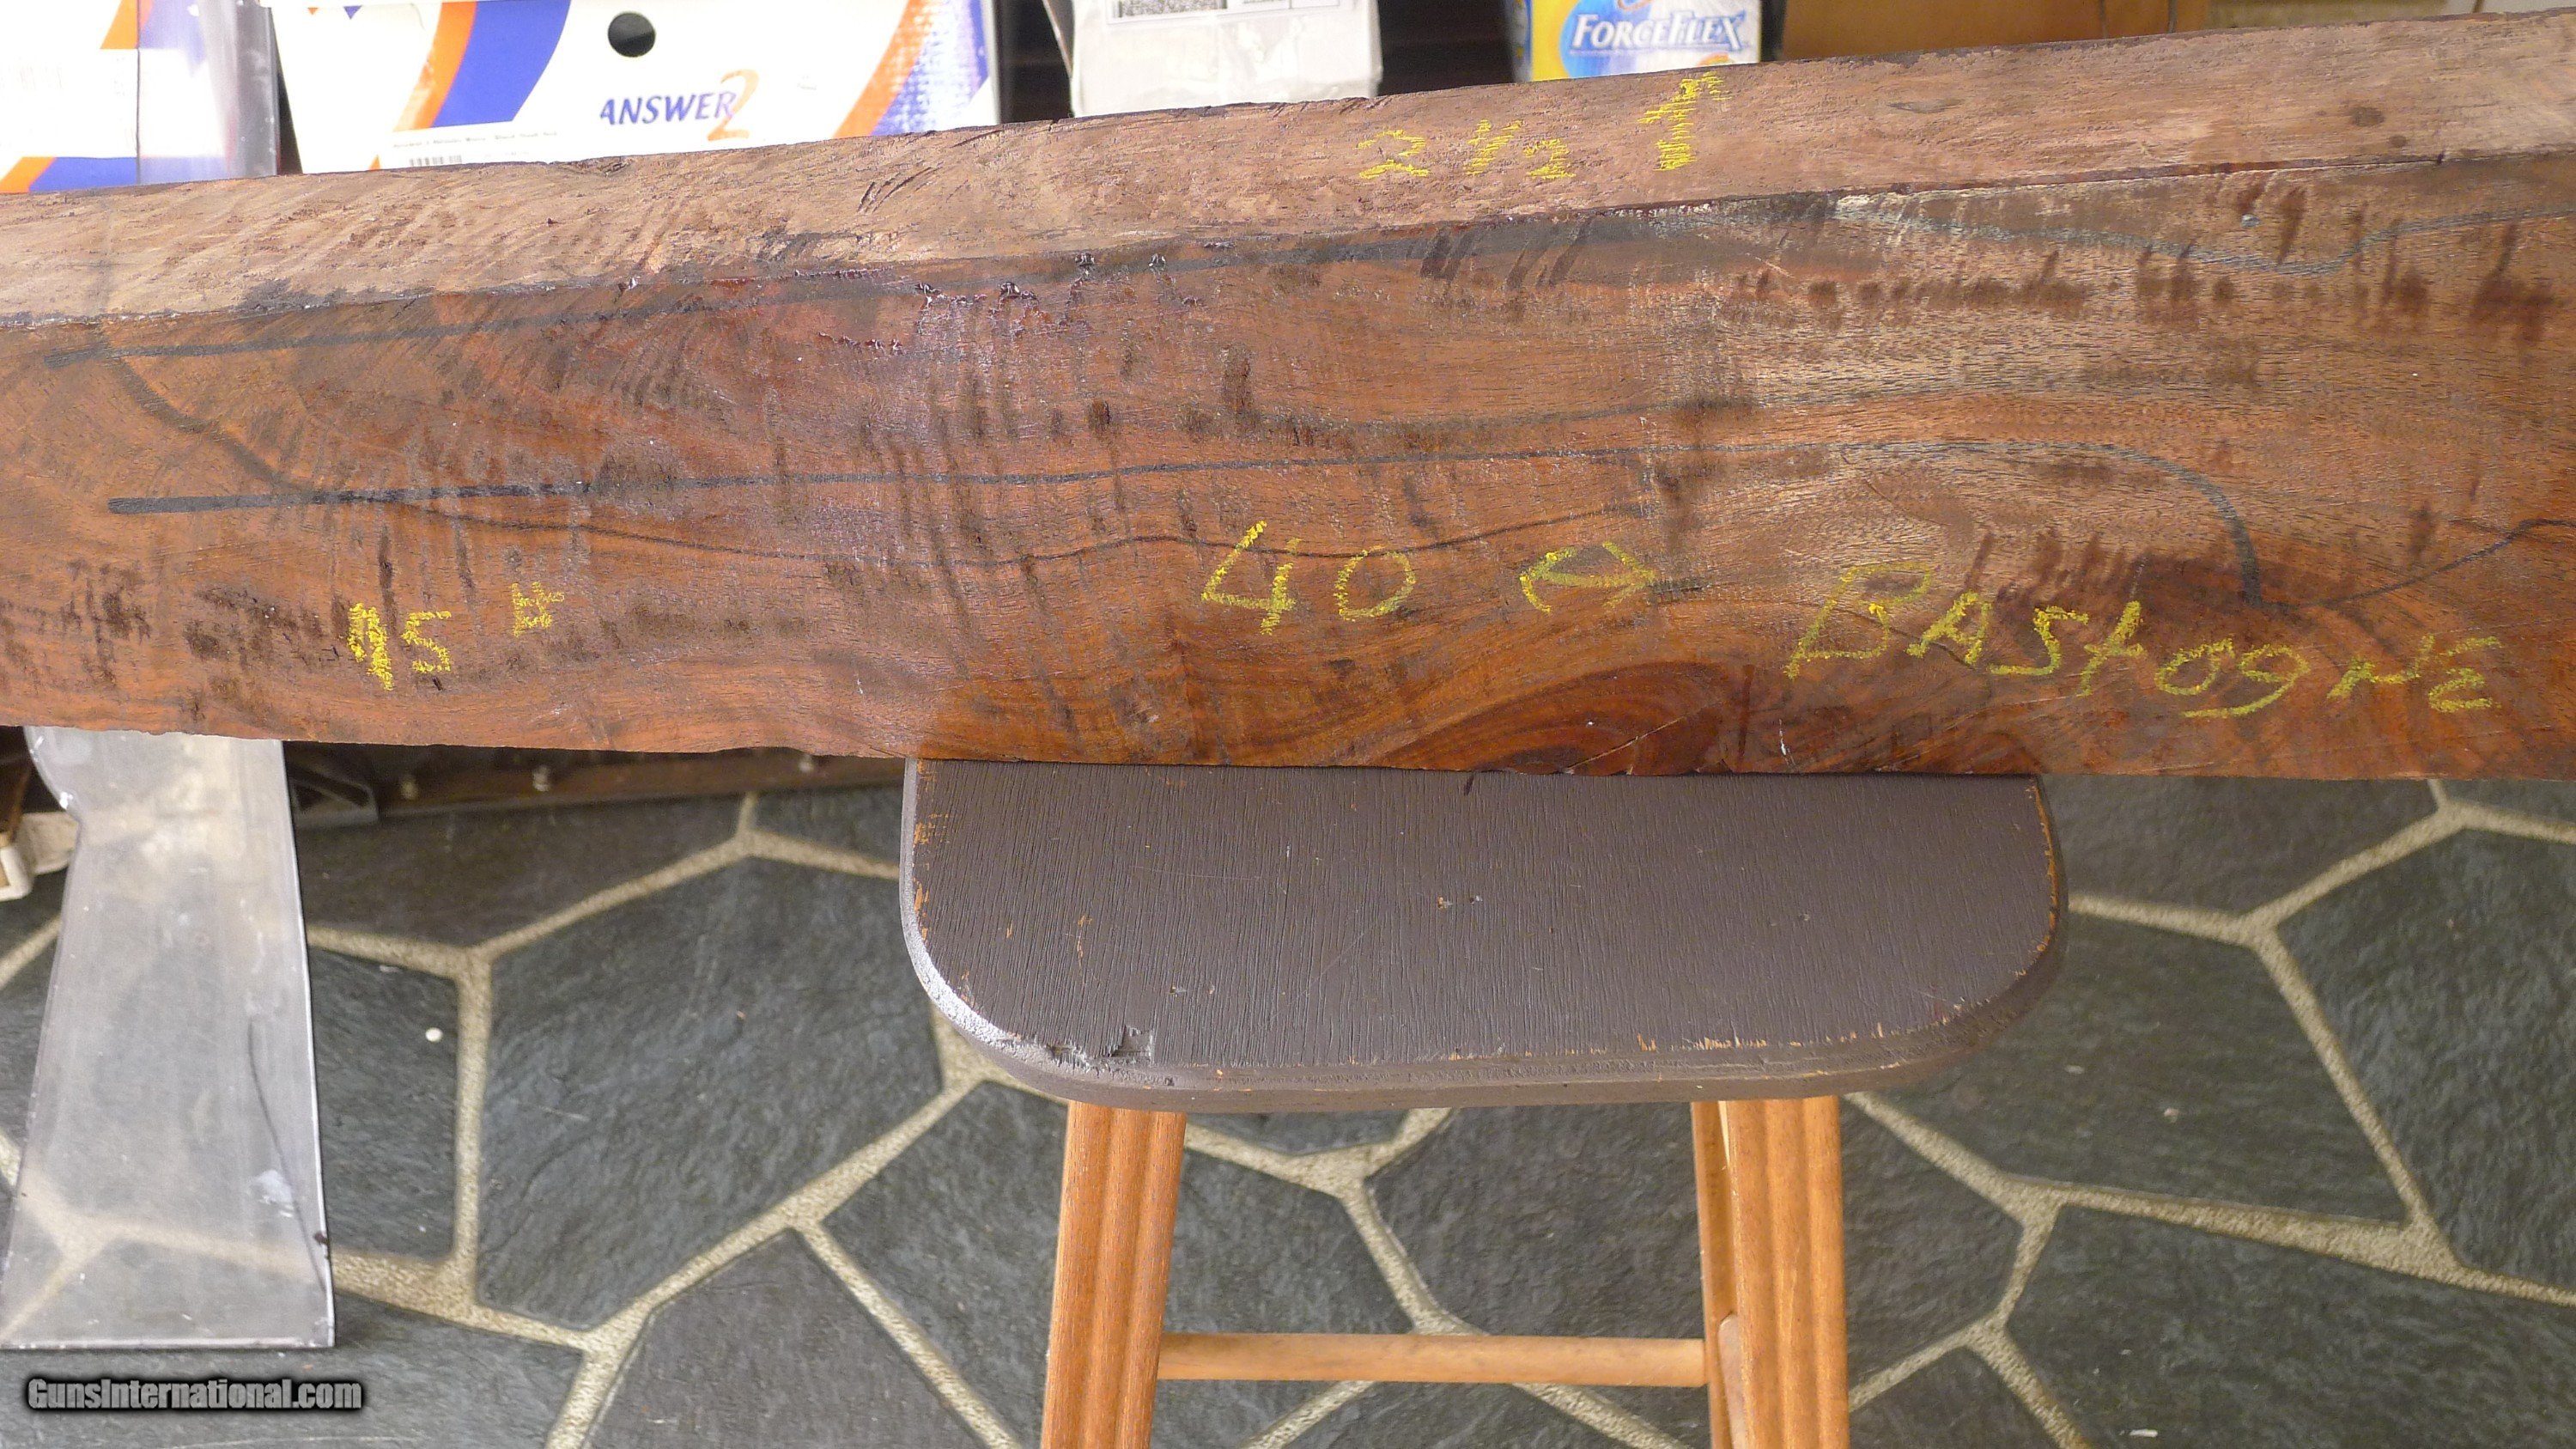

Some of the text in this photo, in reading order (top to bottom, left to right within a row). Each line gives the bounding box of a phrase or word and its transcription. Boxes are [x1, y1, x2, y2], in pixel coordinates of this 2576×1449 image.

[1569, 9, 1746, 52] FORCEFLEX
[599, 68, 760, 142] ANSWER 2
[1200, 520, 1418, 636] 40
